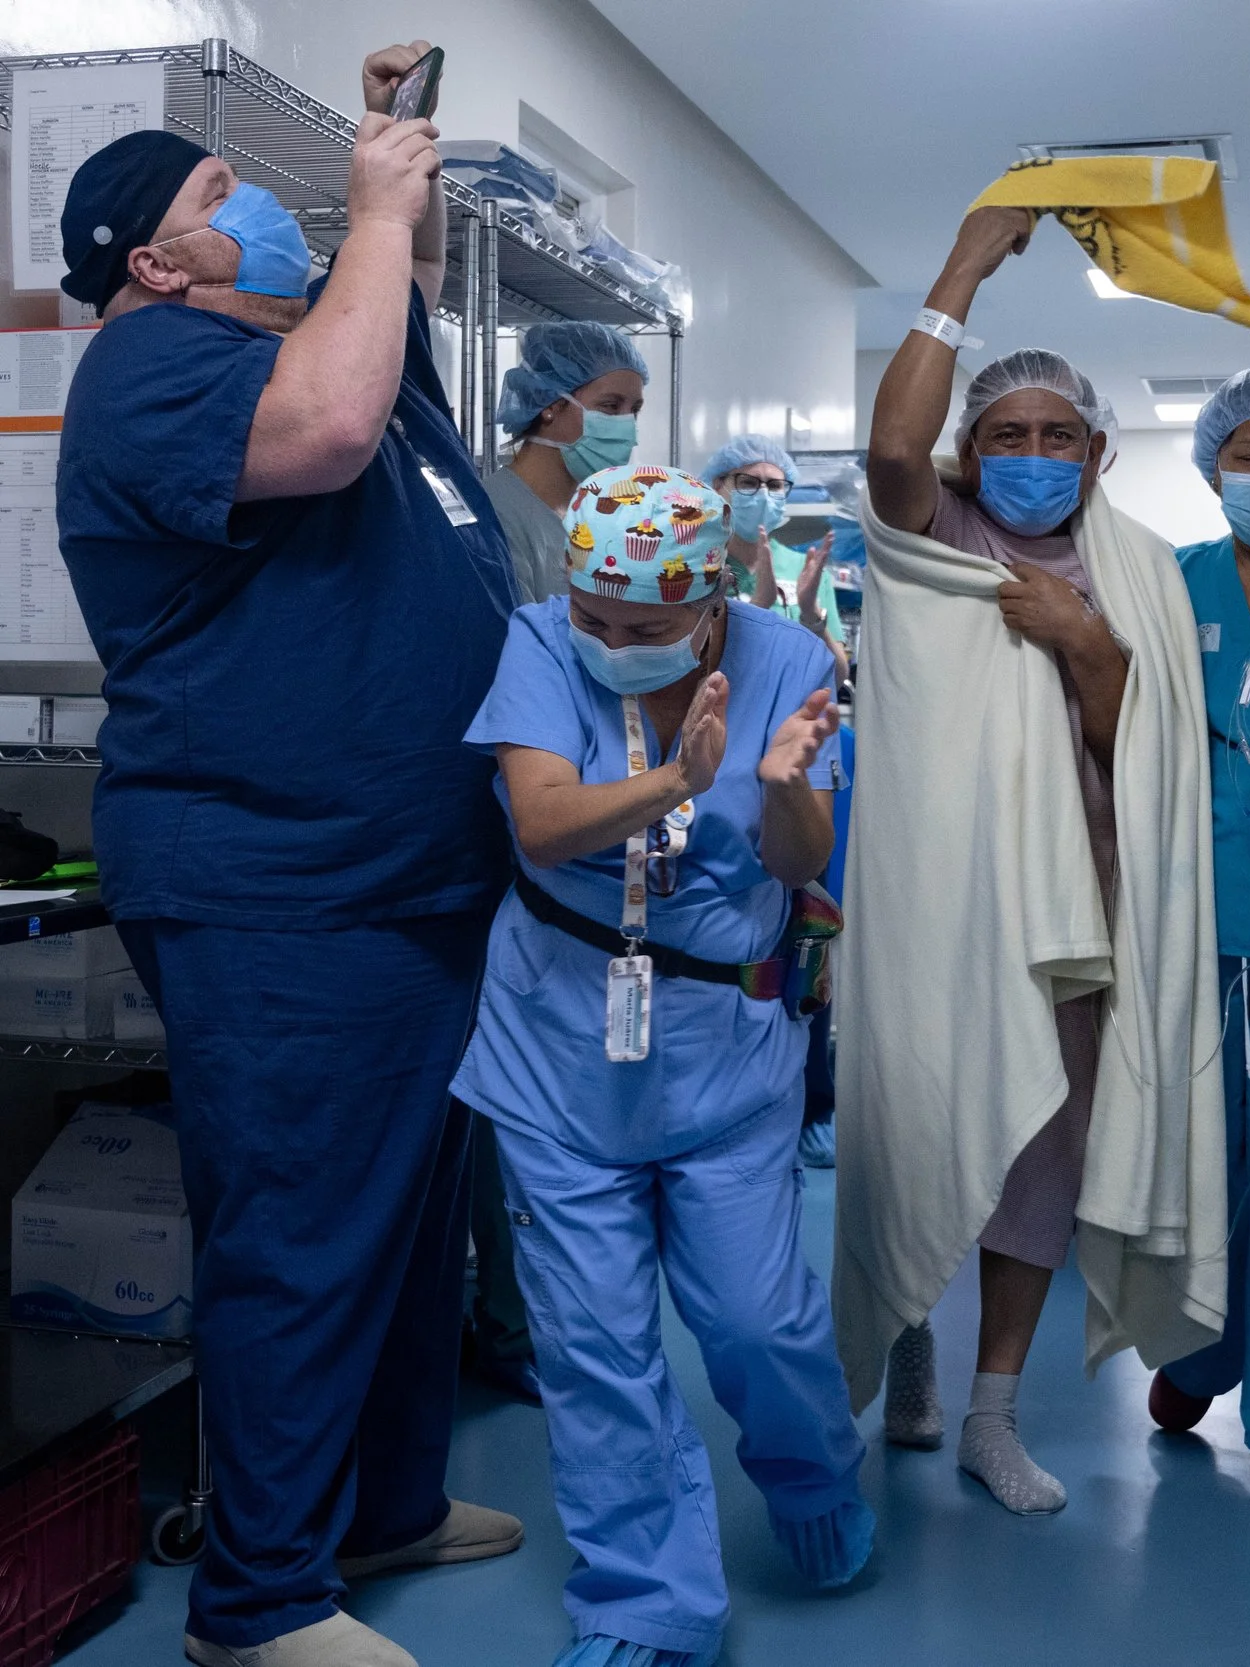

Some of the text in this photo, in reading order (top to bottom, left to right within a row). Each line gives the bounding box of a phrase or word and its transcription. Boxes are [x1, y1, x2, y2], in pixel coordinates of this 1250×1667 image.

[81, 1135, 132, 1155] 60cc
[115, 1281, 155, 1303] 60cc
[23, 1304, 37, 1315] 25
